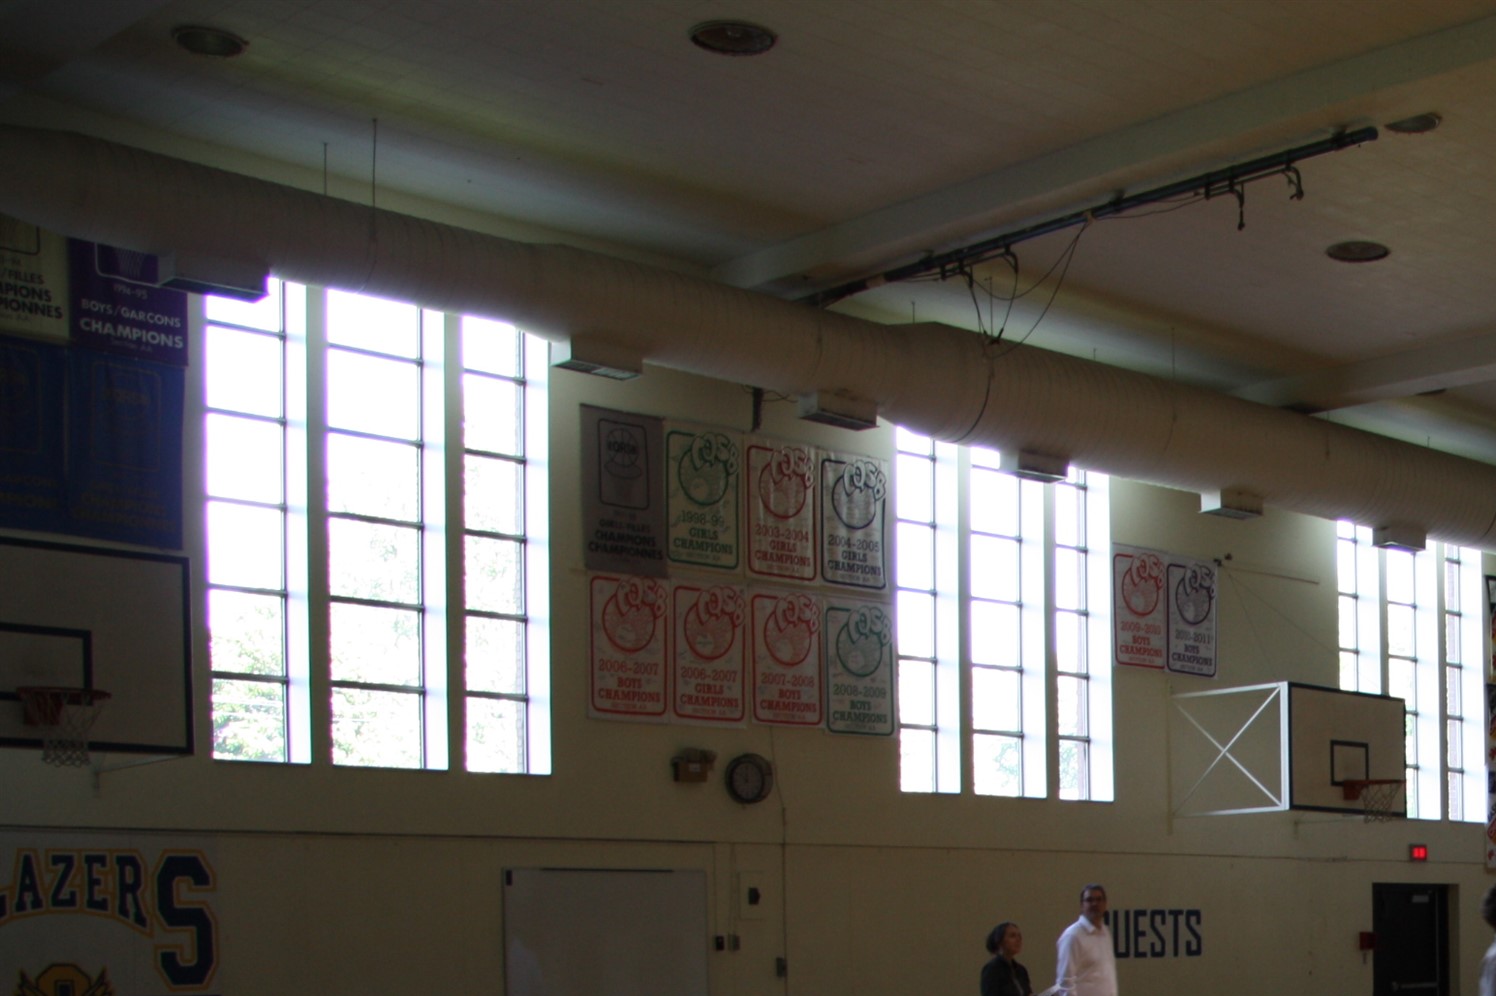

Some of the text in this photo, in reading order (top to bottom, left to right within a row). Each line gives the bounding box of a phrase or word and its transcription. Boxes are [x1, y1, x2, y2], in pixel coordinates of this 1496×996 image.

[79, 318, 184, 349] CHAMPIONS
[595, 530, 656, 547] CHAMPIONS
[689, 527, 719, 540] GIRLS
[589, 541, 662, 560] CHAMPIONNES
[673, 539, 733, 554] CHAMPIONS
[769, 540, 797, 553] GIRLS
[754, 550, 811, 567] CHAMPIONS
[841, 550, 867, 563] GIRLS
[828, 560, 882, 577] CHAMPIONS
[1120, 645, 1163, 659] CHAMPIONS
[1172, 653, 1213, 667] CHAMPIONS
[617, 677, 643, 689] BOYS
[695, 683, 724, 696] GIRLS
[598, 688, 661, 703] CHAMPIONS
[680, 694, 739, 709] CHAMPIONS
[779, 689, 801, 701] BOYS
[760, 699, 817, 713] CHAMPIONS
[849, 700, 872, 711] BOYS
[832, 710, 888, 724] CHAMPIONS
[1103, 909, 1202, 960] UESTS
